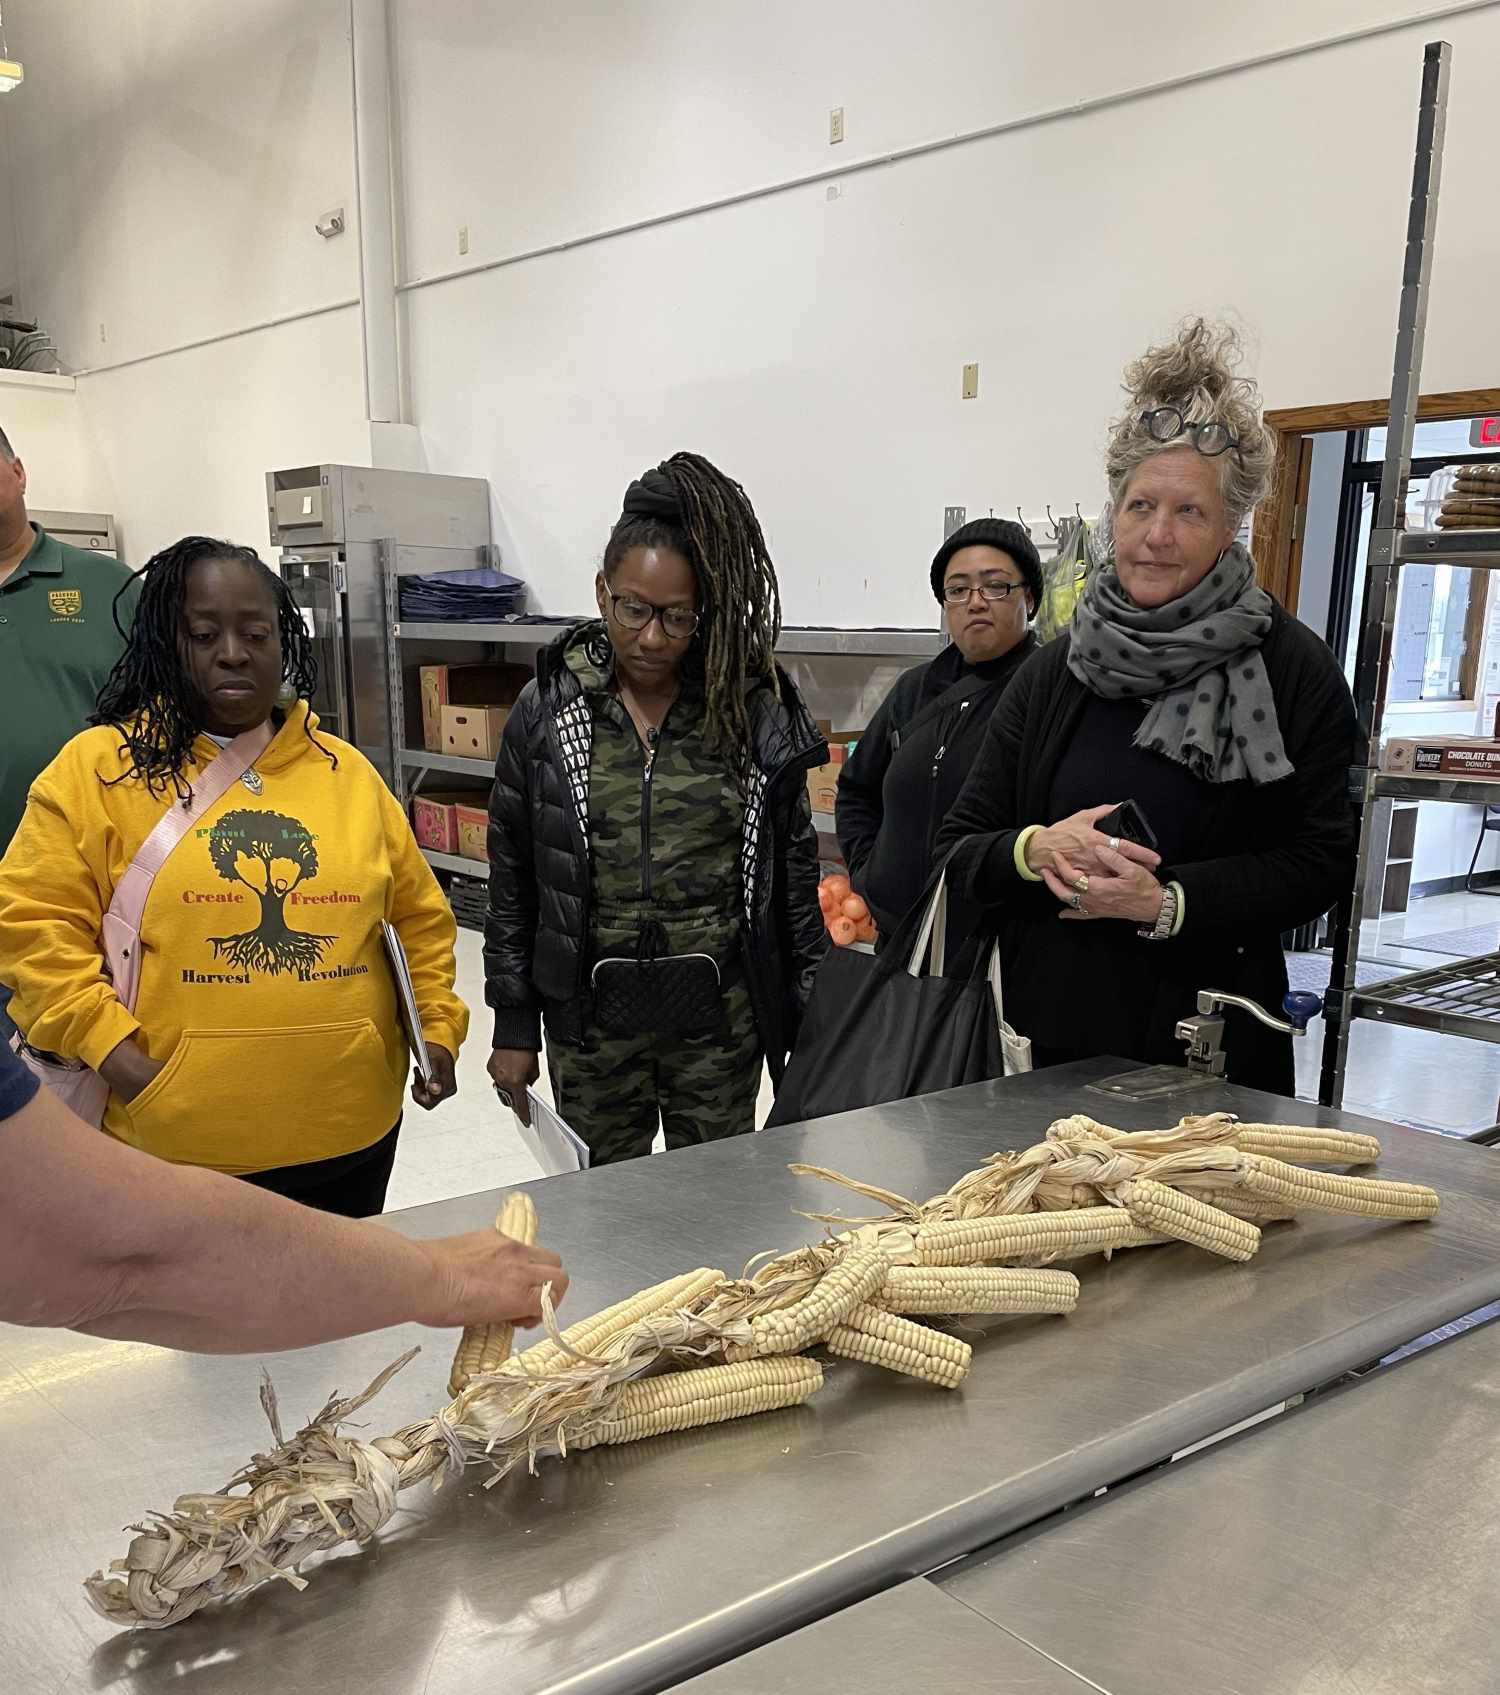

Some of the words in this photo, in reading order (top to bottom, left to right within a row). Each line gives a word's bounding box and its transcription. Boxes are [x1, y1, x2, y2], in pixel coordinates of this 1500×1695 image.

[1447, 750, 1486, 761] CHOCOLATE
[1465, 760, 1492, 769] DONUTS
[182, 889, 245, 905] Create
[290, 890, 361, 906] Freedom
[181, 968, 251, 984] Harvest
[298, 962, 369, 983] Revolution
